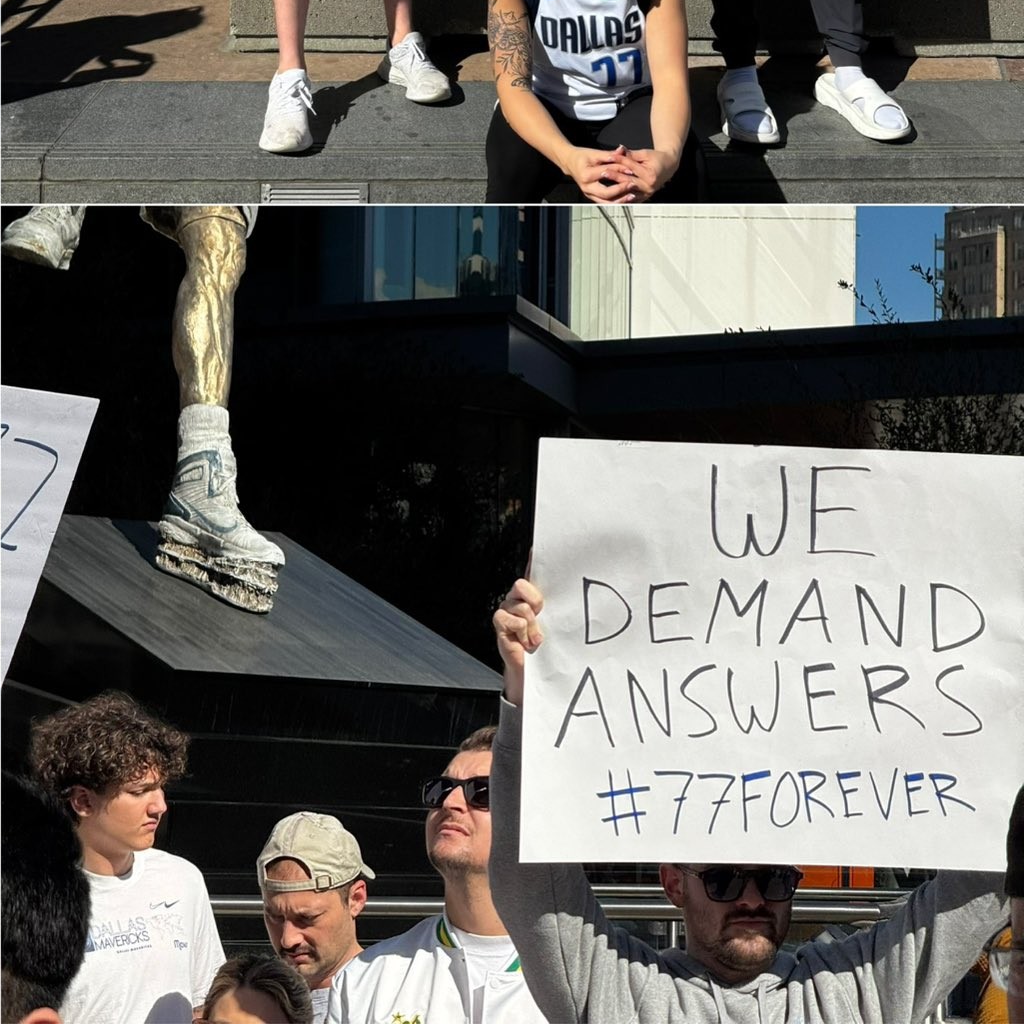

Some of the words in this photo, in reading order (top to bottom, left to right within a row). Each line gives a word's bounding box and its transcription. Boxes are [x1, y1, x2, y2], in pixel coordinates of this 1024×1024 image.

[540, 10, 642, 54] DALLAS
[591, 49, 643, 87] 77
[710, 463, 876, 558] WE
[583, 576, 986, 652] DEMAND
[554, 661, 983, 749] ANSWERS
[596, 767, 977, 836] #77FOREVER
[94, 931, 150, 952] MAVERICKS
